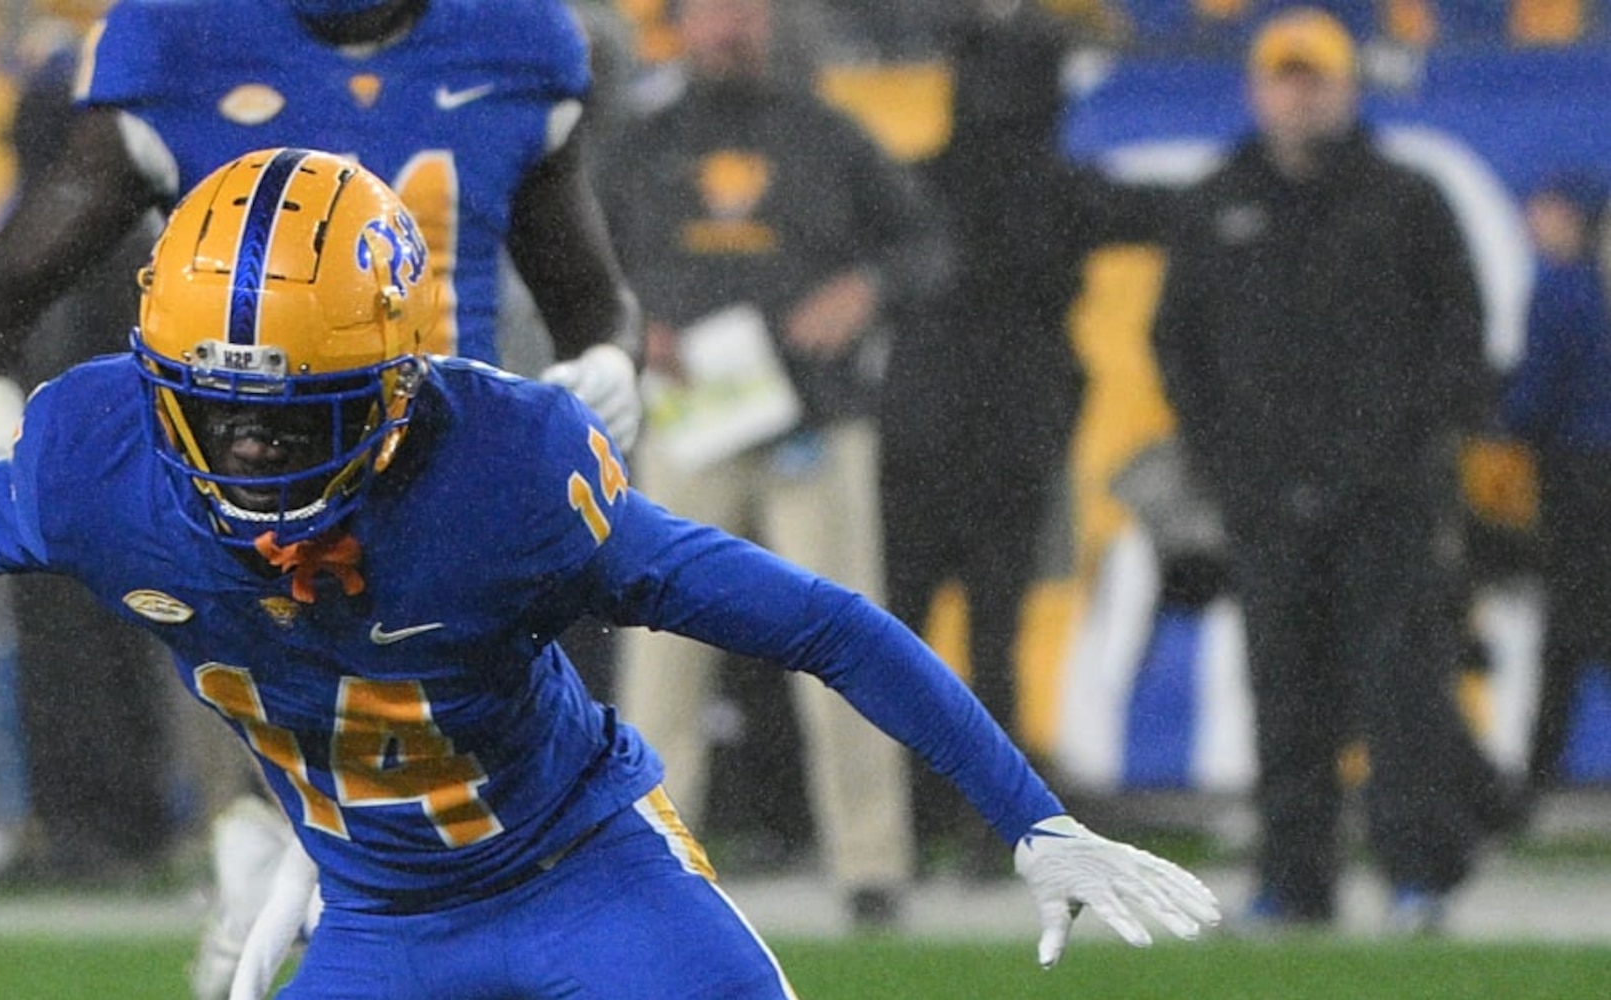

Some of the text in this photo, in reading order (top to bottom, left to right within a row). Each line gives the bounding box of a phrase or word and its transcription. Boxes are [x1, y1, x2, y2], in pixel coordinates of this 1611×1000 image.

[223, 350, 254, 370] H2P
[567, 423, 629, 547] 14
[192, 661, 505, 848] 14
